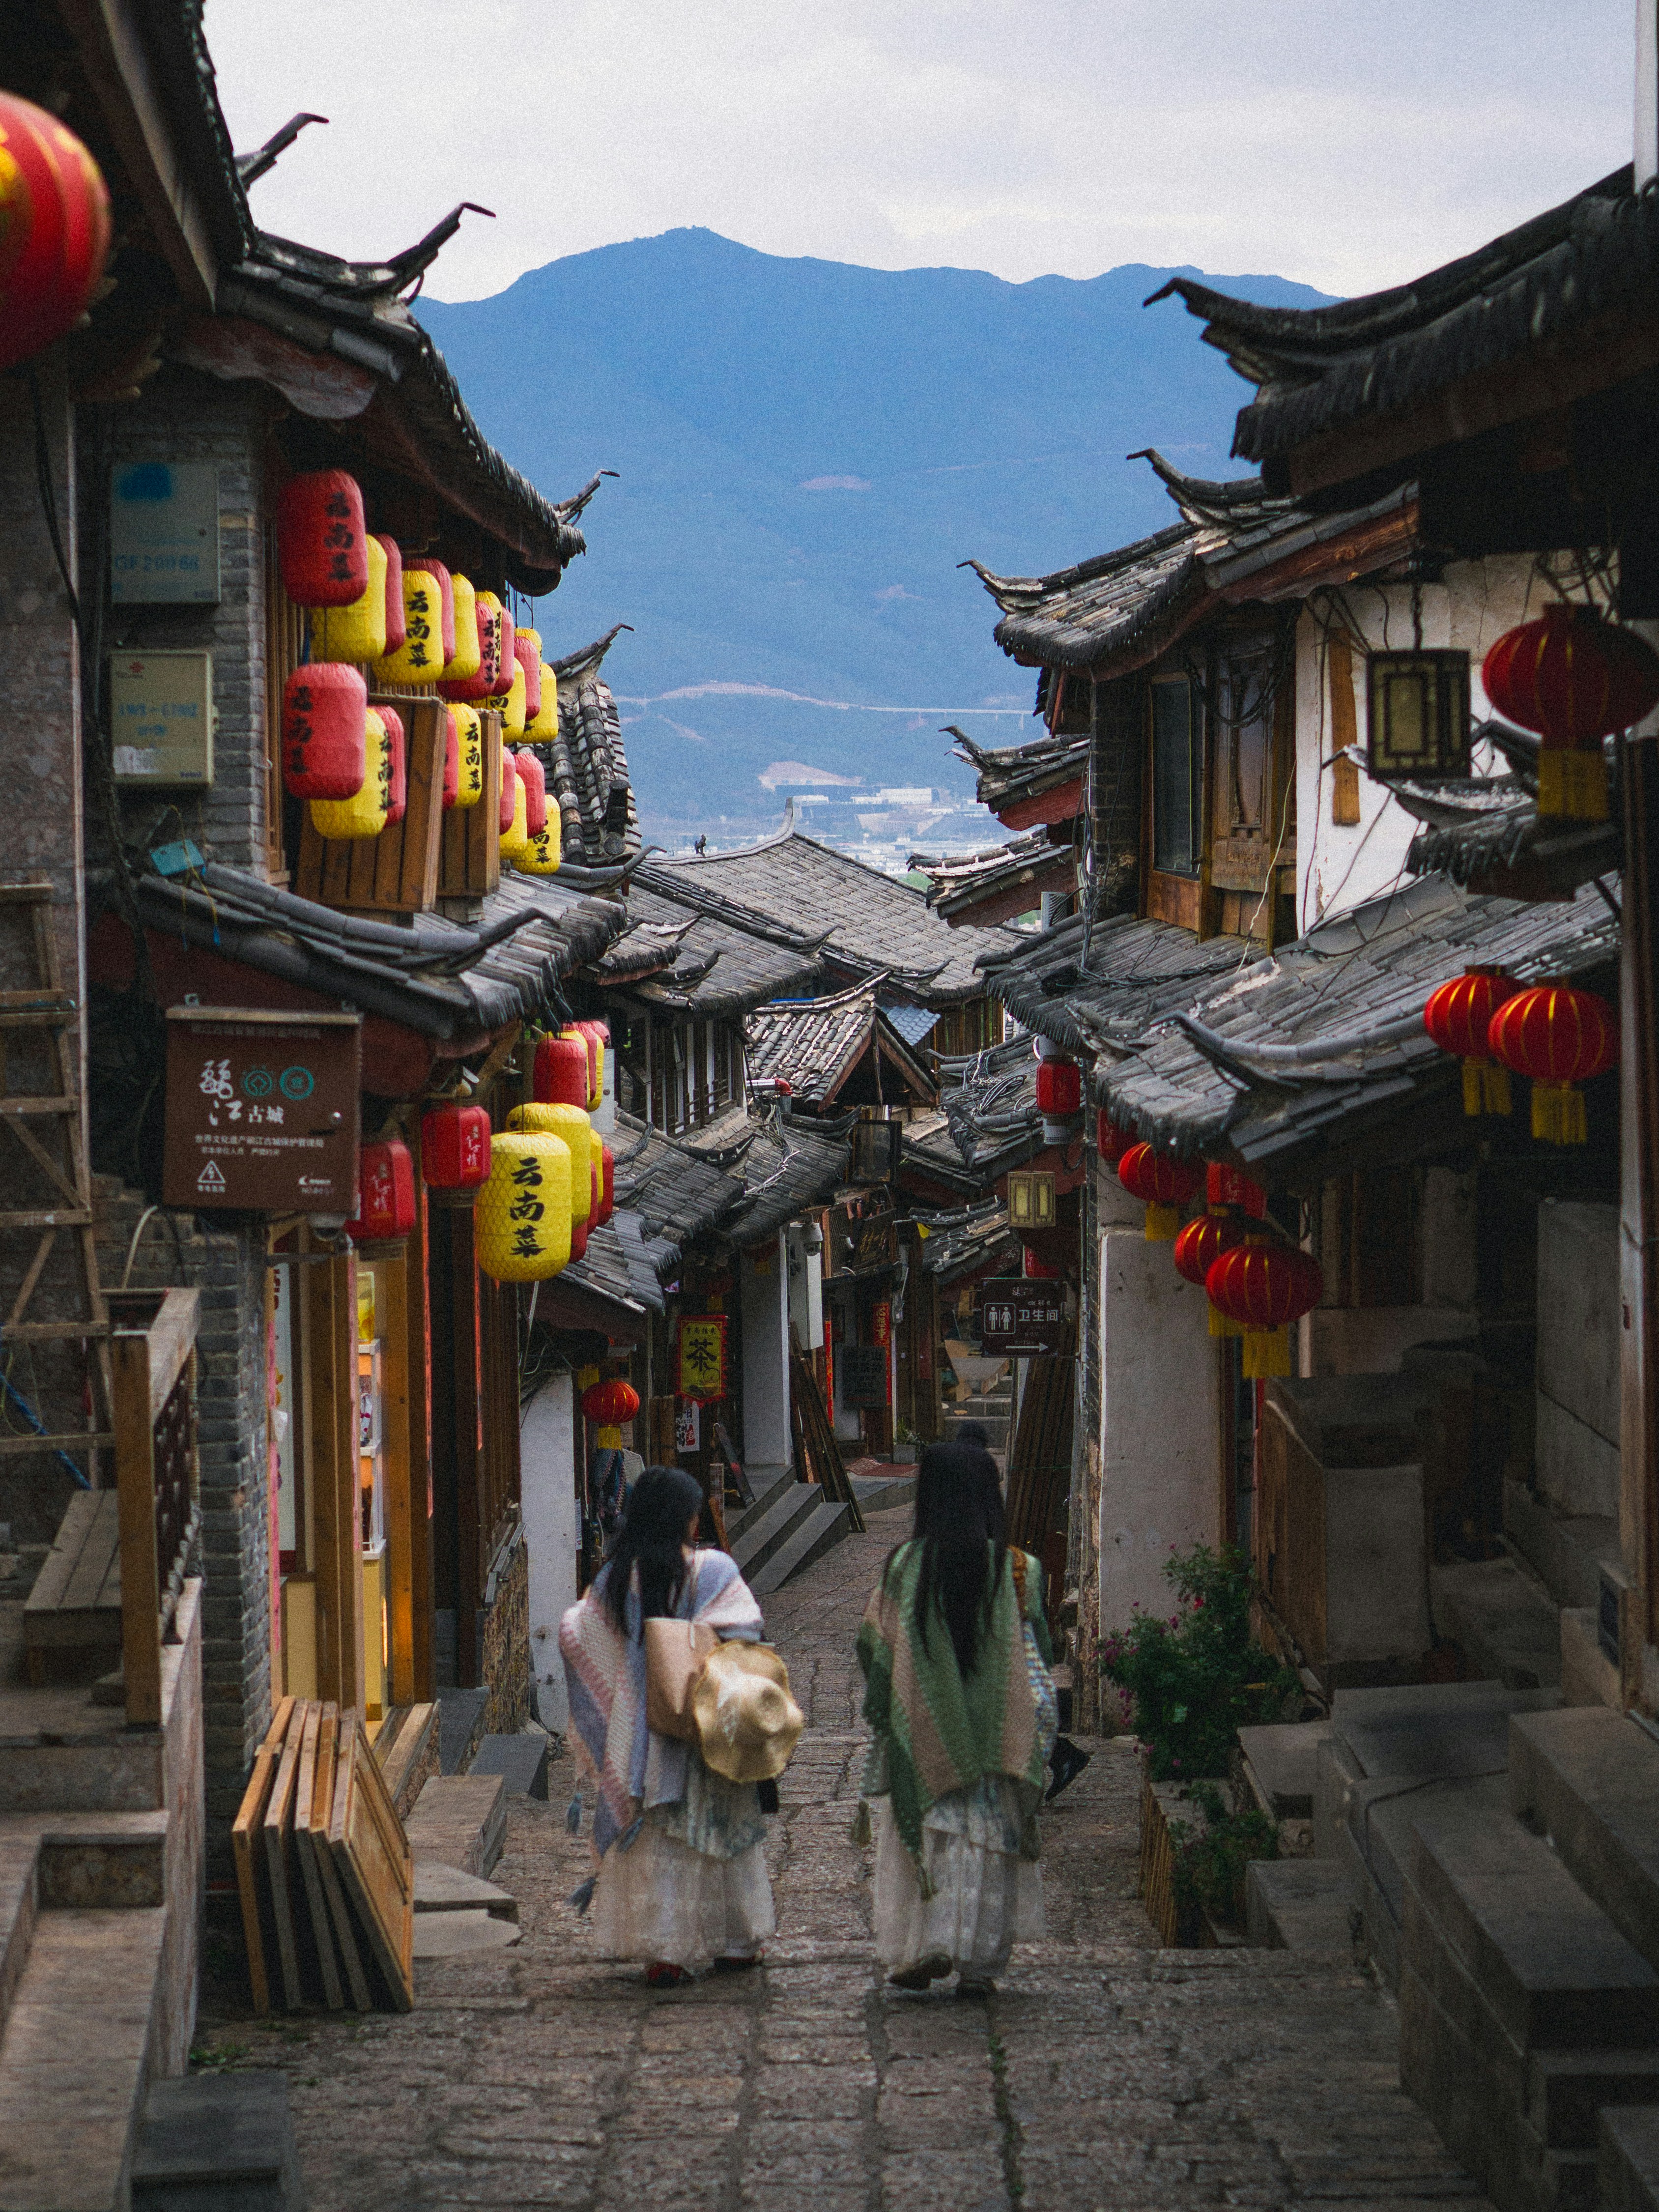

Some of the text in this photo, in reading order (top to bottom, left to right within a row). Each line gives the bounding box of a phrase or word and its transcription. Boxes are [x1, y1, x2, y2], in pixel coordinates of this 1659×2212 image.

[406, 590, 432, 667] 云南菜
[483, 619, 495, 683] 云南菜
[465, 722, 481, 791] 云南菜
[510, 1156, 546, 1259] 云南菜
[1018, 1309, 1058, 1322] 卫生间
[686, 1338, 717, 1372] 茶
